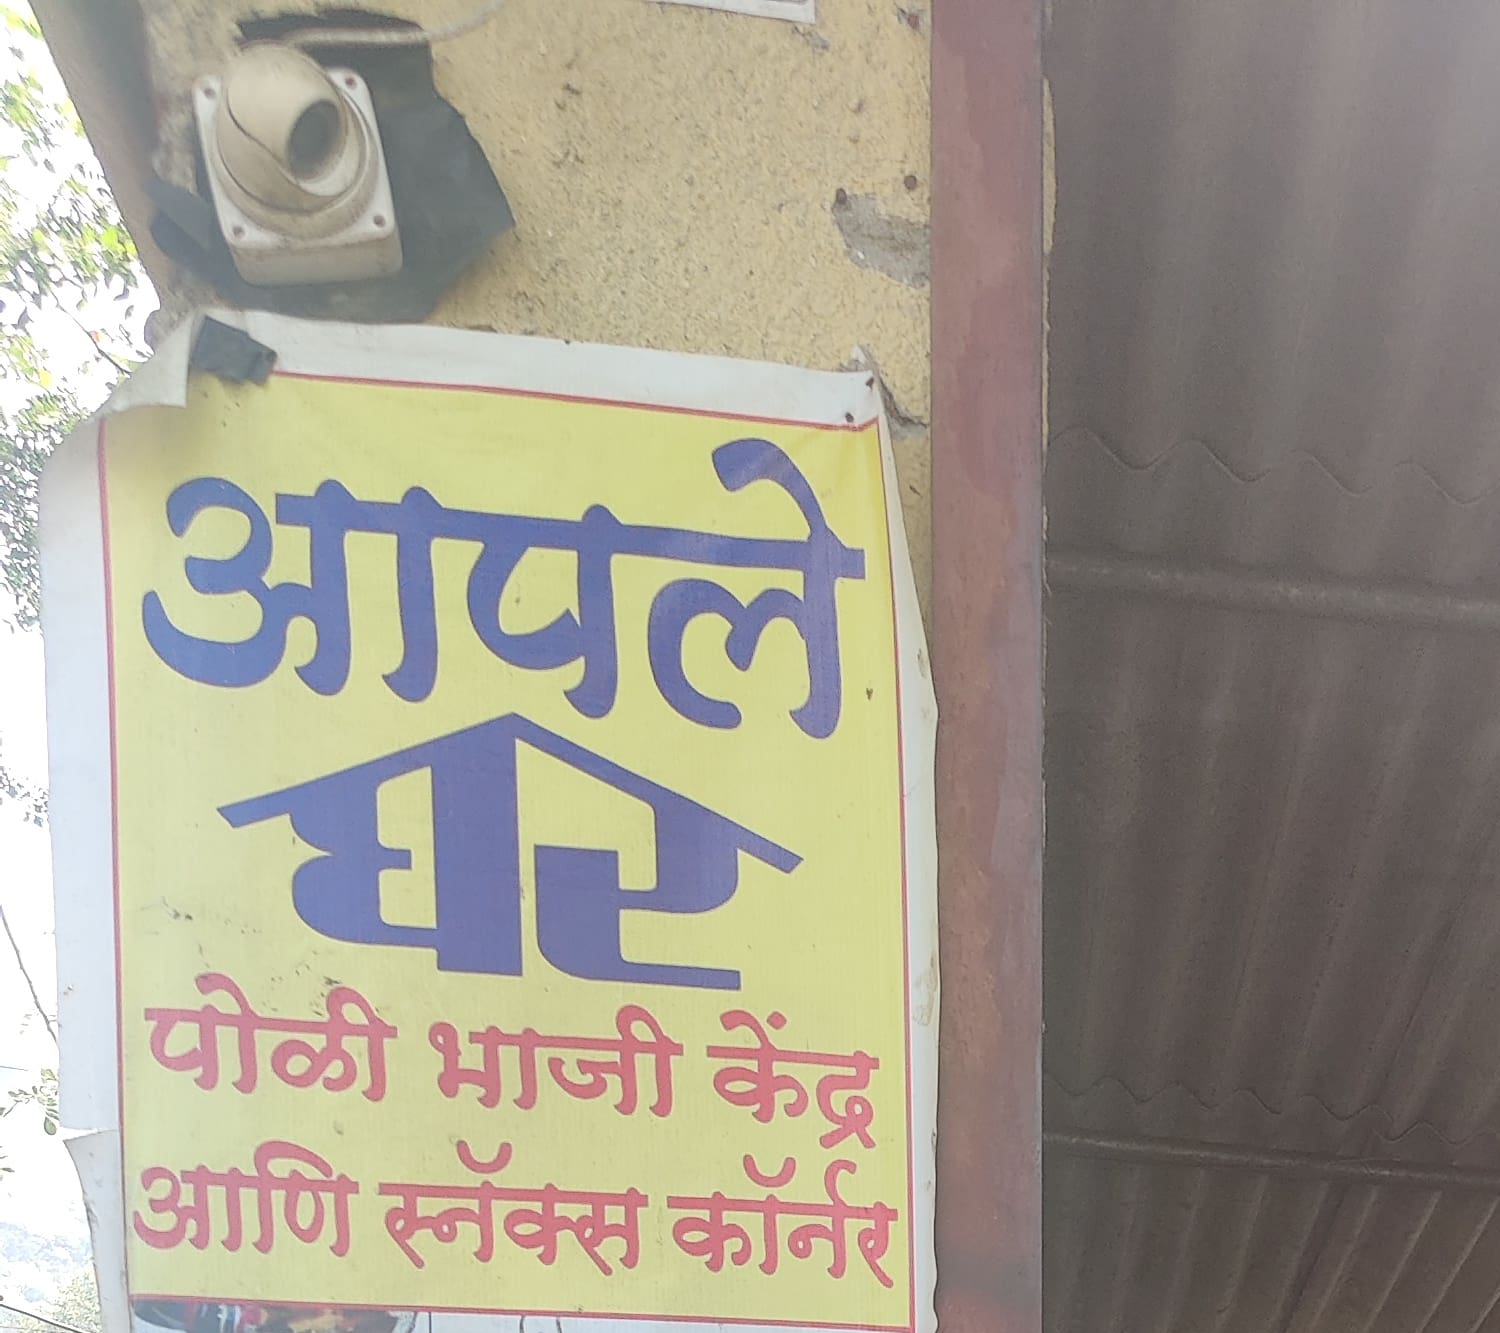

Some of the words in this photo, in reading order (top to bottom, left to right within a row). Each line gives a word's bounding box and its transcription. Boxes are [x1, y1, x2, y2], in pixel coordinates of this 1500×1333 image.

[142, 438, 865, 739] आपले
[216, 712, 804, 990] घर
[145, 972, 398, 1102] पोळी
[429, 1004, 684, 1118] भाजी
[707, 1010, 880, 1149] केंद्र
[134, 1140, 360, 1256] आणि
[378, 1140, 650, 1275] स्नॅक्स
[666, 1154, 899, 1288] कॉर्नर
